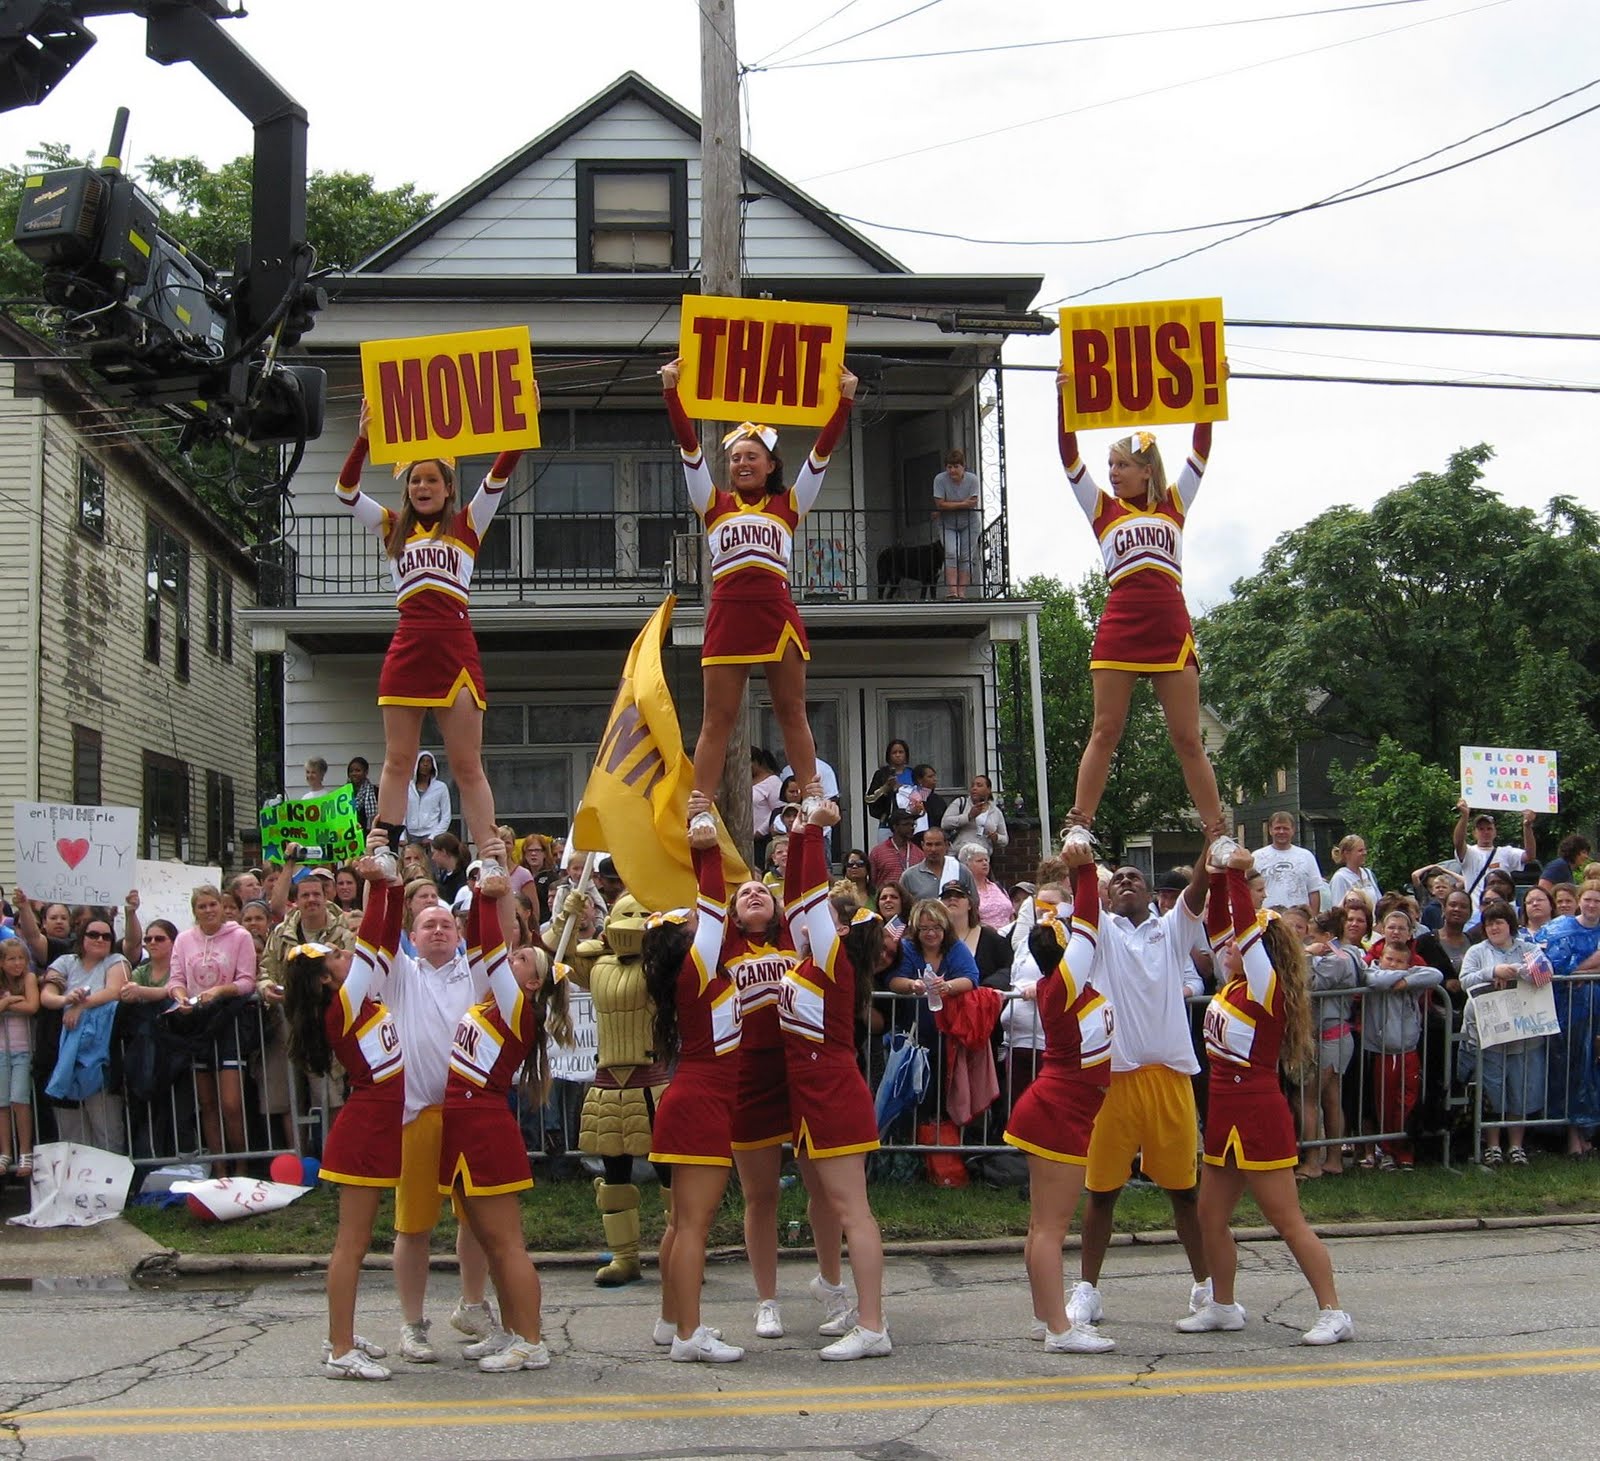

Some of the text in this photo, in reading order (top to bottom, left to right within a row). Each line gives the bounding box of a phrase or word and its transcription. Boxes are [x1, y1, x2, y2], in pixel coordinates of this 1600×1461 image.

[379, 317, 1219, 444] MOVE THAT BUS!
[720, 524, 782, 556] GANNON
[1114, 525, 1176, 556] GANNON
[397, 546, 459, 578] GANNON
[1472, 752, 1547, 765] WELCOME
[1489, 766, 1529, 777] HOME
[1487, 780, 1532, 790] CLARA
[1490, 793, 1529, 803] WARD
[18, 839, 131, 868] WE TY
[84, 885, 110, 903] Pie
